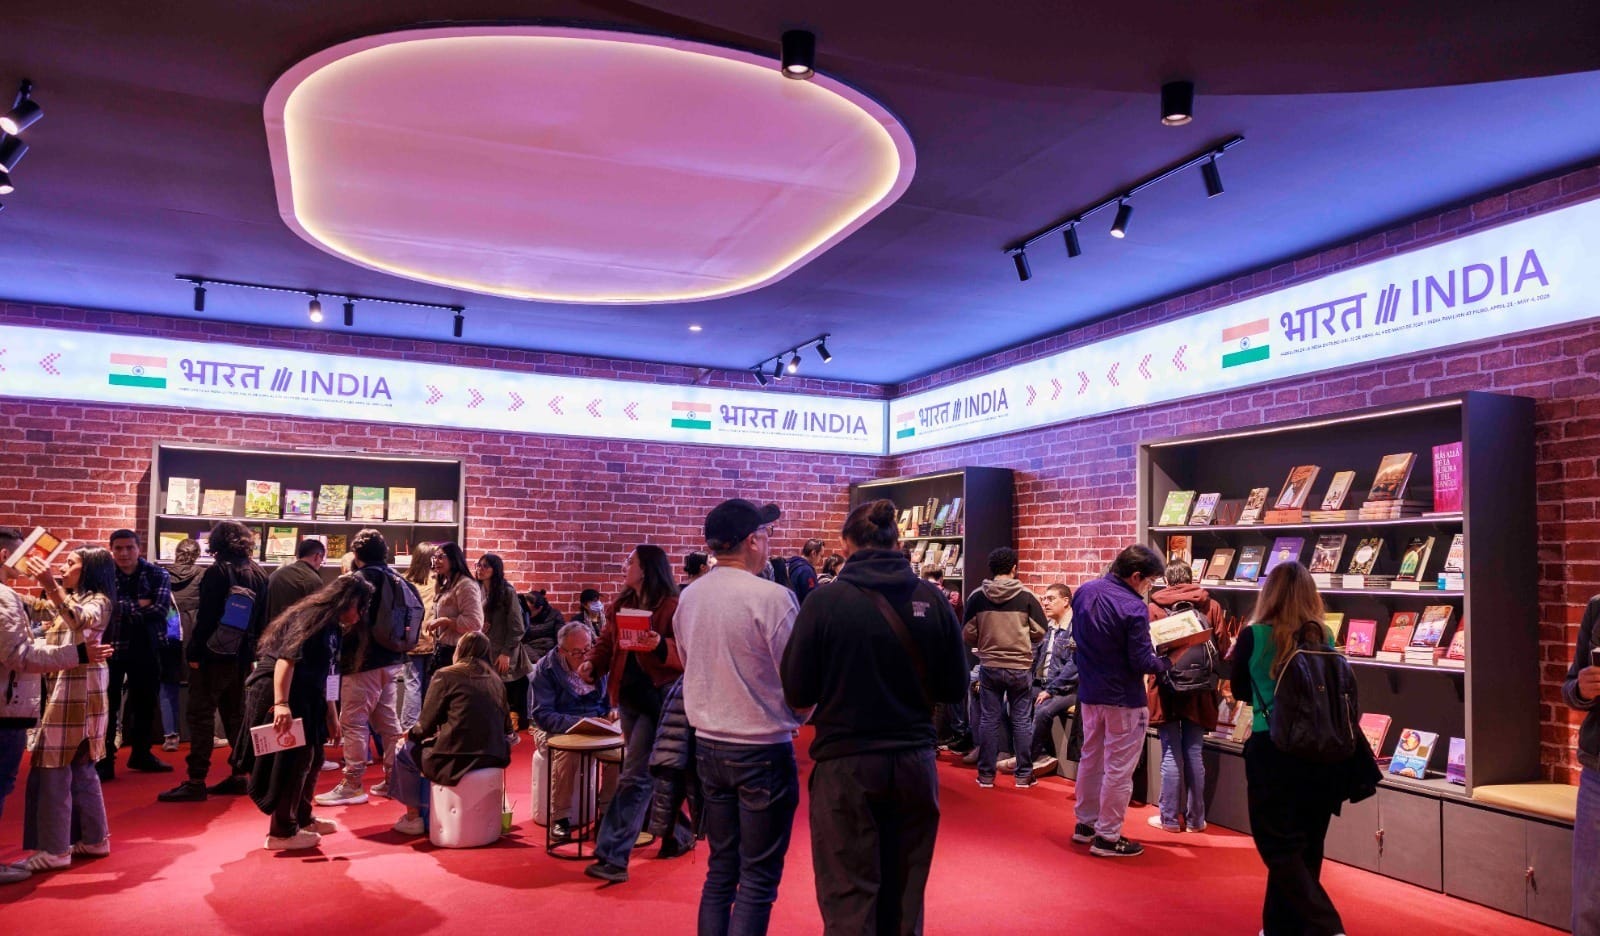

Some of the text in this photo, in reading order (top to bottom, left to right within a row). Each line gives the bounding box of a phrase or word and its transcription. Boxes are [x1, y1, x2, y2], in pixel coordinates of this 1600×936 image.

[1412, 249, 1549, 316] INDIA
[1280, 293, 1367, 341] भारत
[179, 358, 264, 390] भारत
[302, 369, 392, 400] INDIA
[719, 404, 778, 429] भारत
[918, 401, 950, 428] भारत
[964, 387, 1008, 419] INDIA
[803, 411, 867, 435] INDIA
